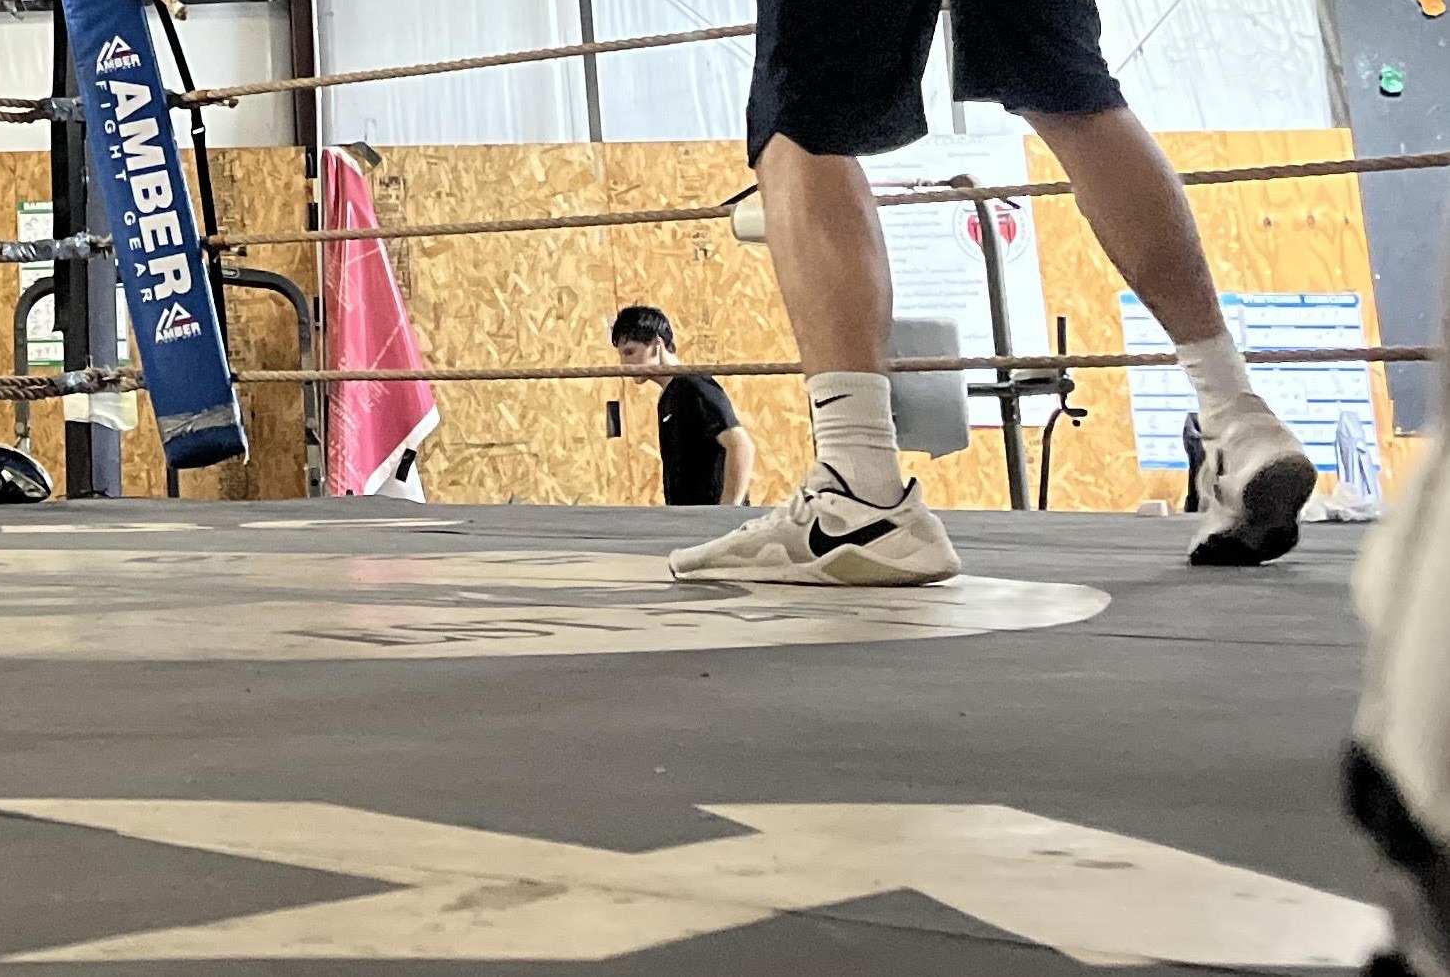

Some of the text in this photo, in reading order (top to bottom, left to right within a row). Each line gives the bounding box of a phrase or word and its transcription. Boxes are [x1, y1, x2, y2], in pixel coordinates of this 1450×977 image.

[95, 53, 142, 74] AMBER
[95, 81, 153, 303] FIGHT GEAR
[109, 80, 191, 301] AMBER
[155, 321, 202, 343] AMBER
